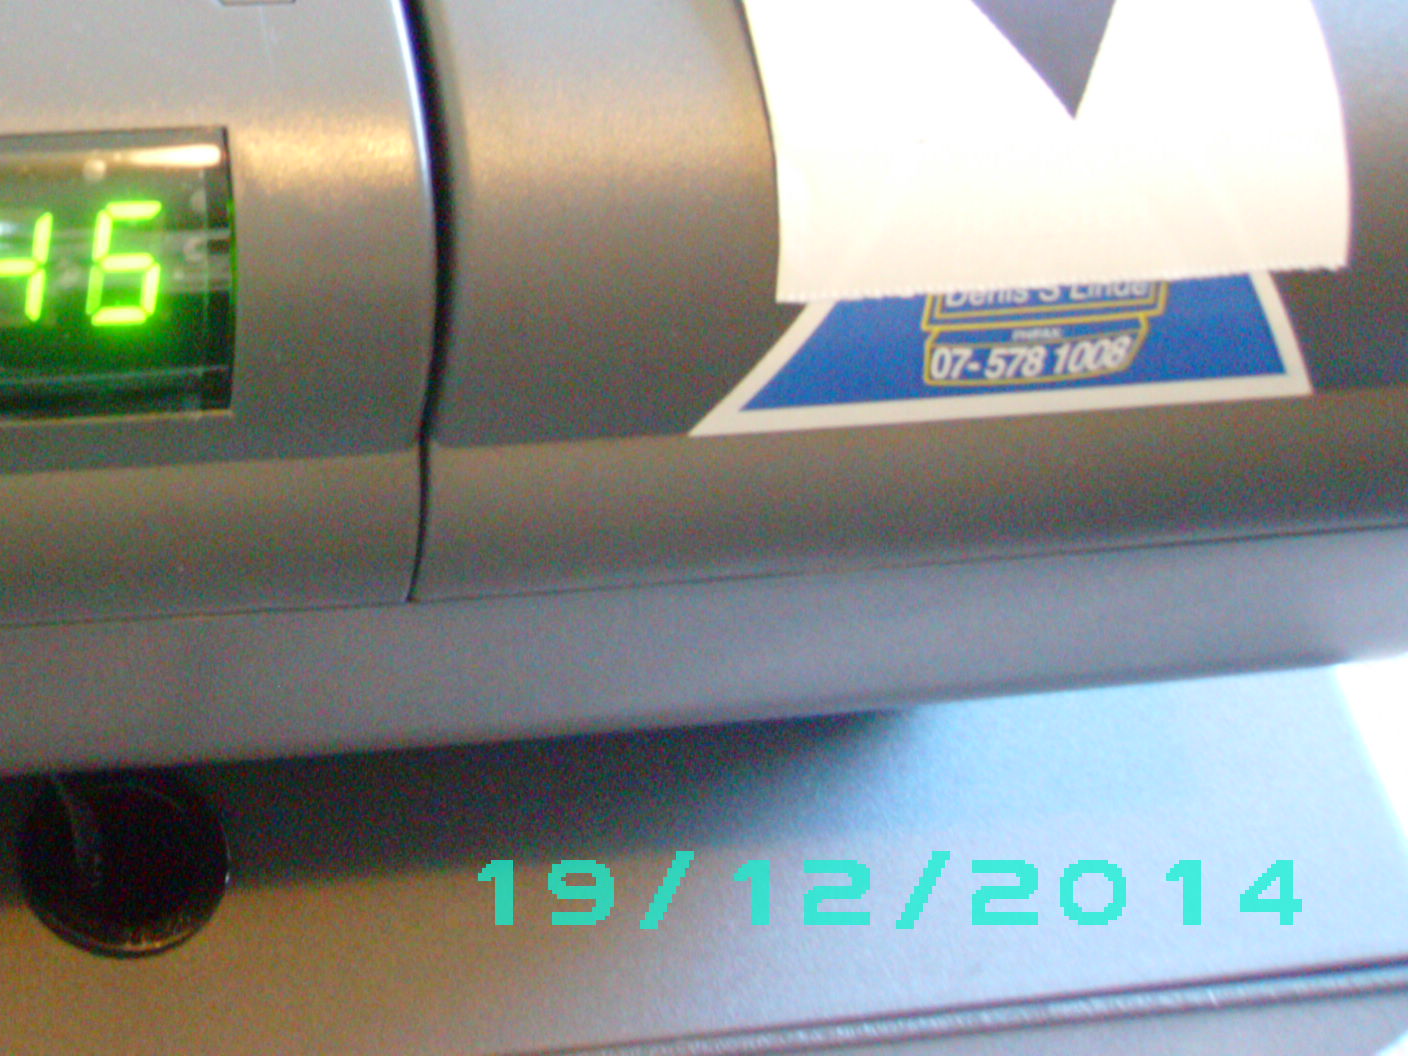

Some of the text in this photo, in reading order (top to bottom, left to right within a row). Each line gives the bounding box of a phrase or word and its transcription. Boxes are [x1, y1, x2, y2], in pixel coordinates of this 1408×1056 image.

[930, 335, 1132, 380] 07- 578 1008
